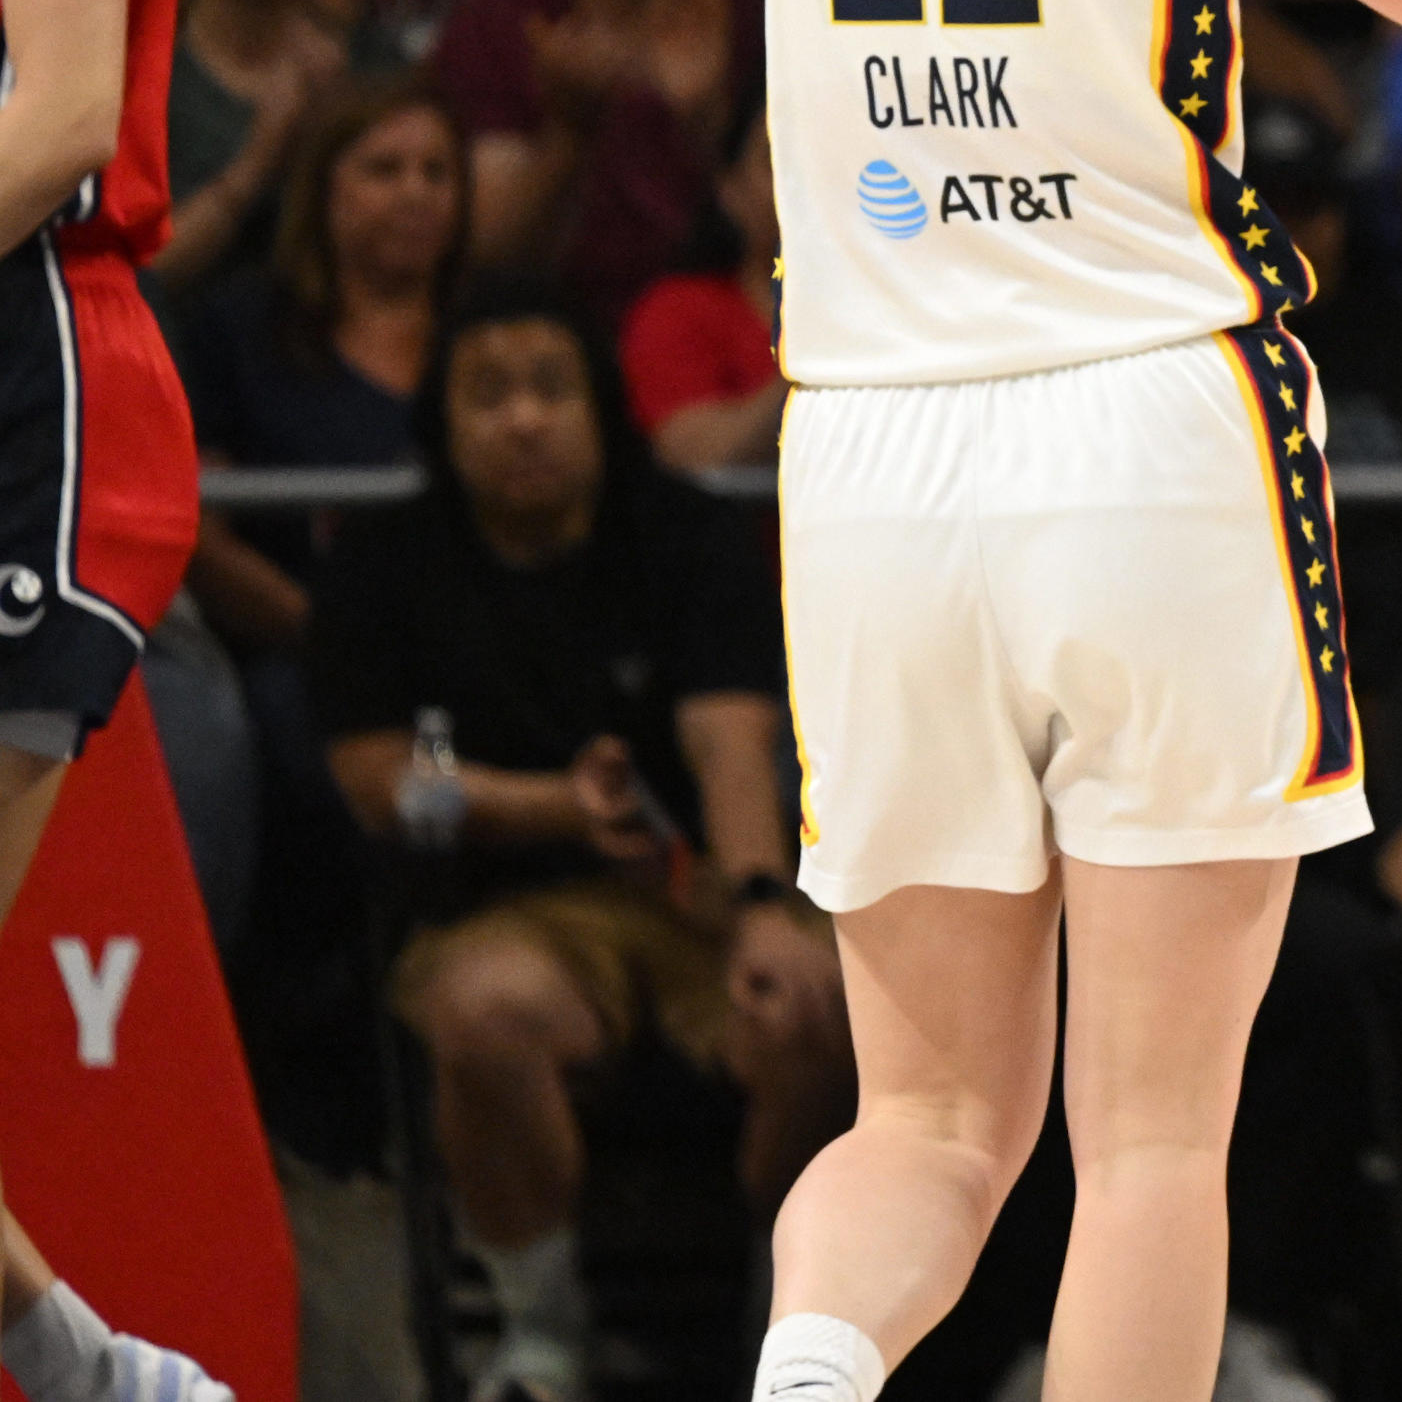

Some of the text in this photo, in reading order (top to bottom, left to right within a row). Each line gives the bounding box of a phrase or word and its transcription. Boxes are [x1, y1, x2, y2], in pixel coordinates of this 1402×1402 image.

[863, 54, 1019, 130] CLARK
[939, 172, 1079, 224] AT&T
[50, 934, 142, 1069] Y
